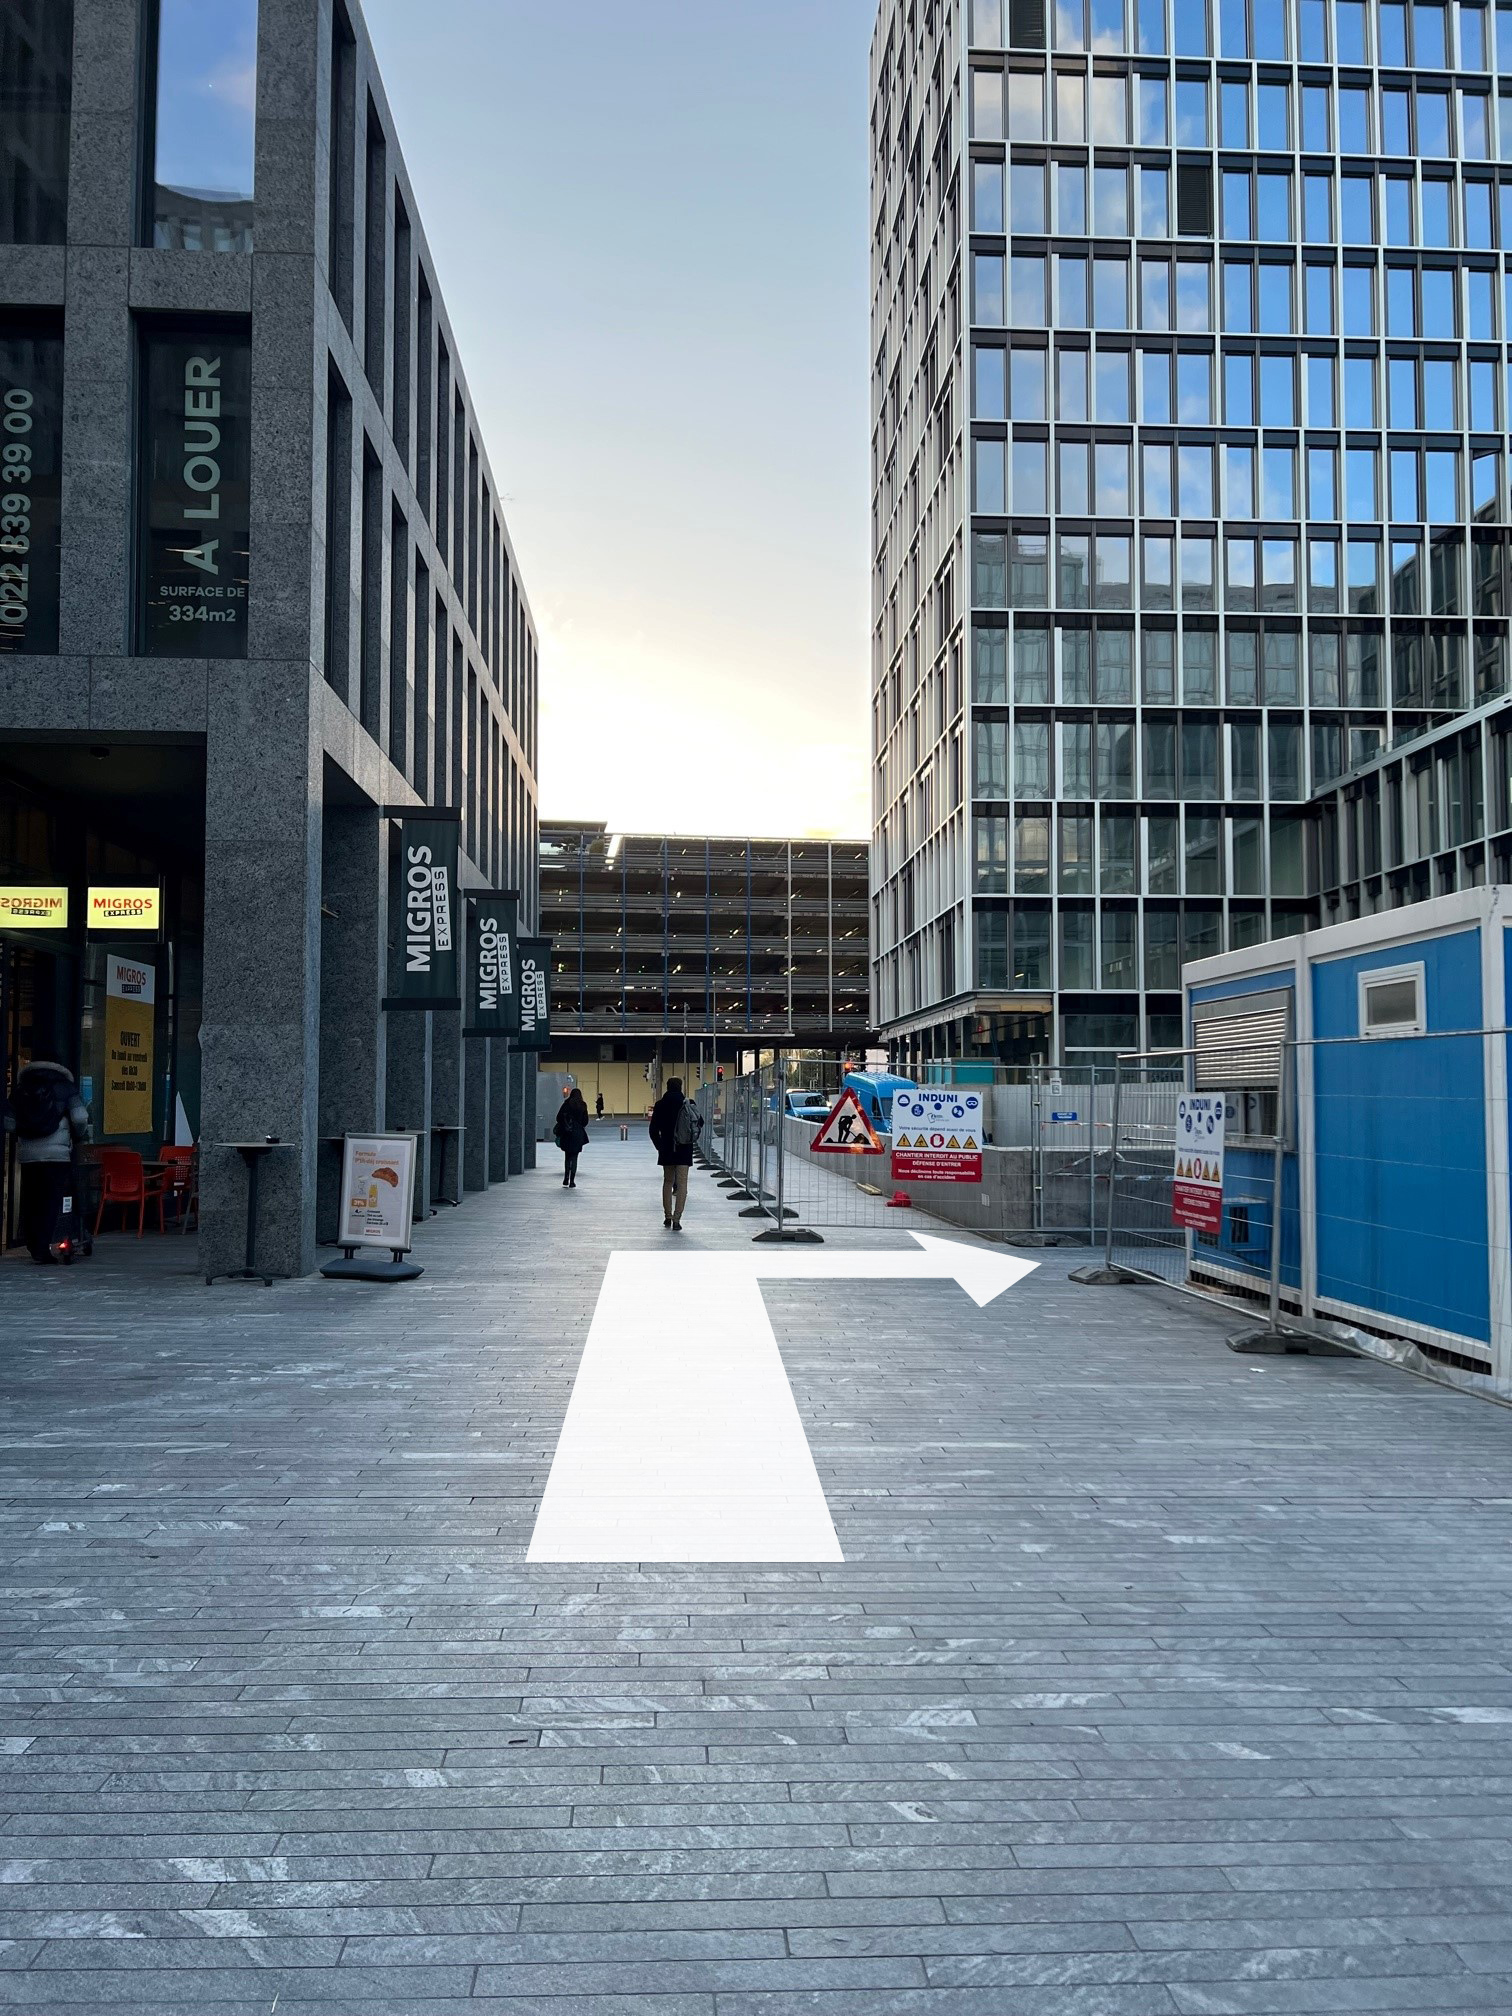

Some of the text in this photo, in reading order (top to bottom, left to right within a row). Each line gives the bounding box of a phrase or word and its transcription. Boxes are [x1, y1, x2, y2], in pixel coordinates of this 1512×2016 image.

[183, 356, 221, 519] LOUER
[0, 388, 33, 624] 022 839 39 00
[160, 586, 246, 598] SURFACE DE
[169, 604, 236, 622] 334m2
[93, 898, 153, 909] MIGROS
[105, 909, 142, 917] EXPRESS
[406, 845, 432, 972] MIGROS
[434, 870, 448, 947] EXPRESS
[117, 965, 146, 985] MIGROS
[479, 917, 498, 1010] MIGROS
[498, 936, 510, 992] EXPRESS
[521, 959, 536, 1032] MIGROS
[536, 973, 546, 1017] EXPRESS
[120, 1031, 140, 1047] OUVERT
[919, 1093, 958, 1103] INDUNI
[1190, 1098, 1211, 1110] INDUNI
